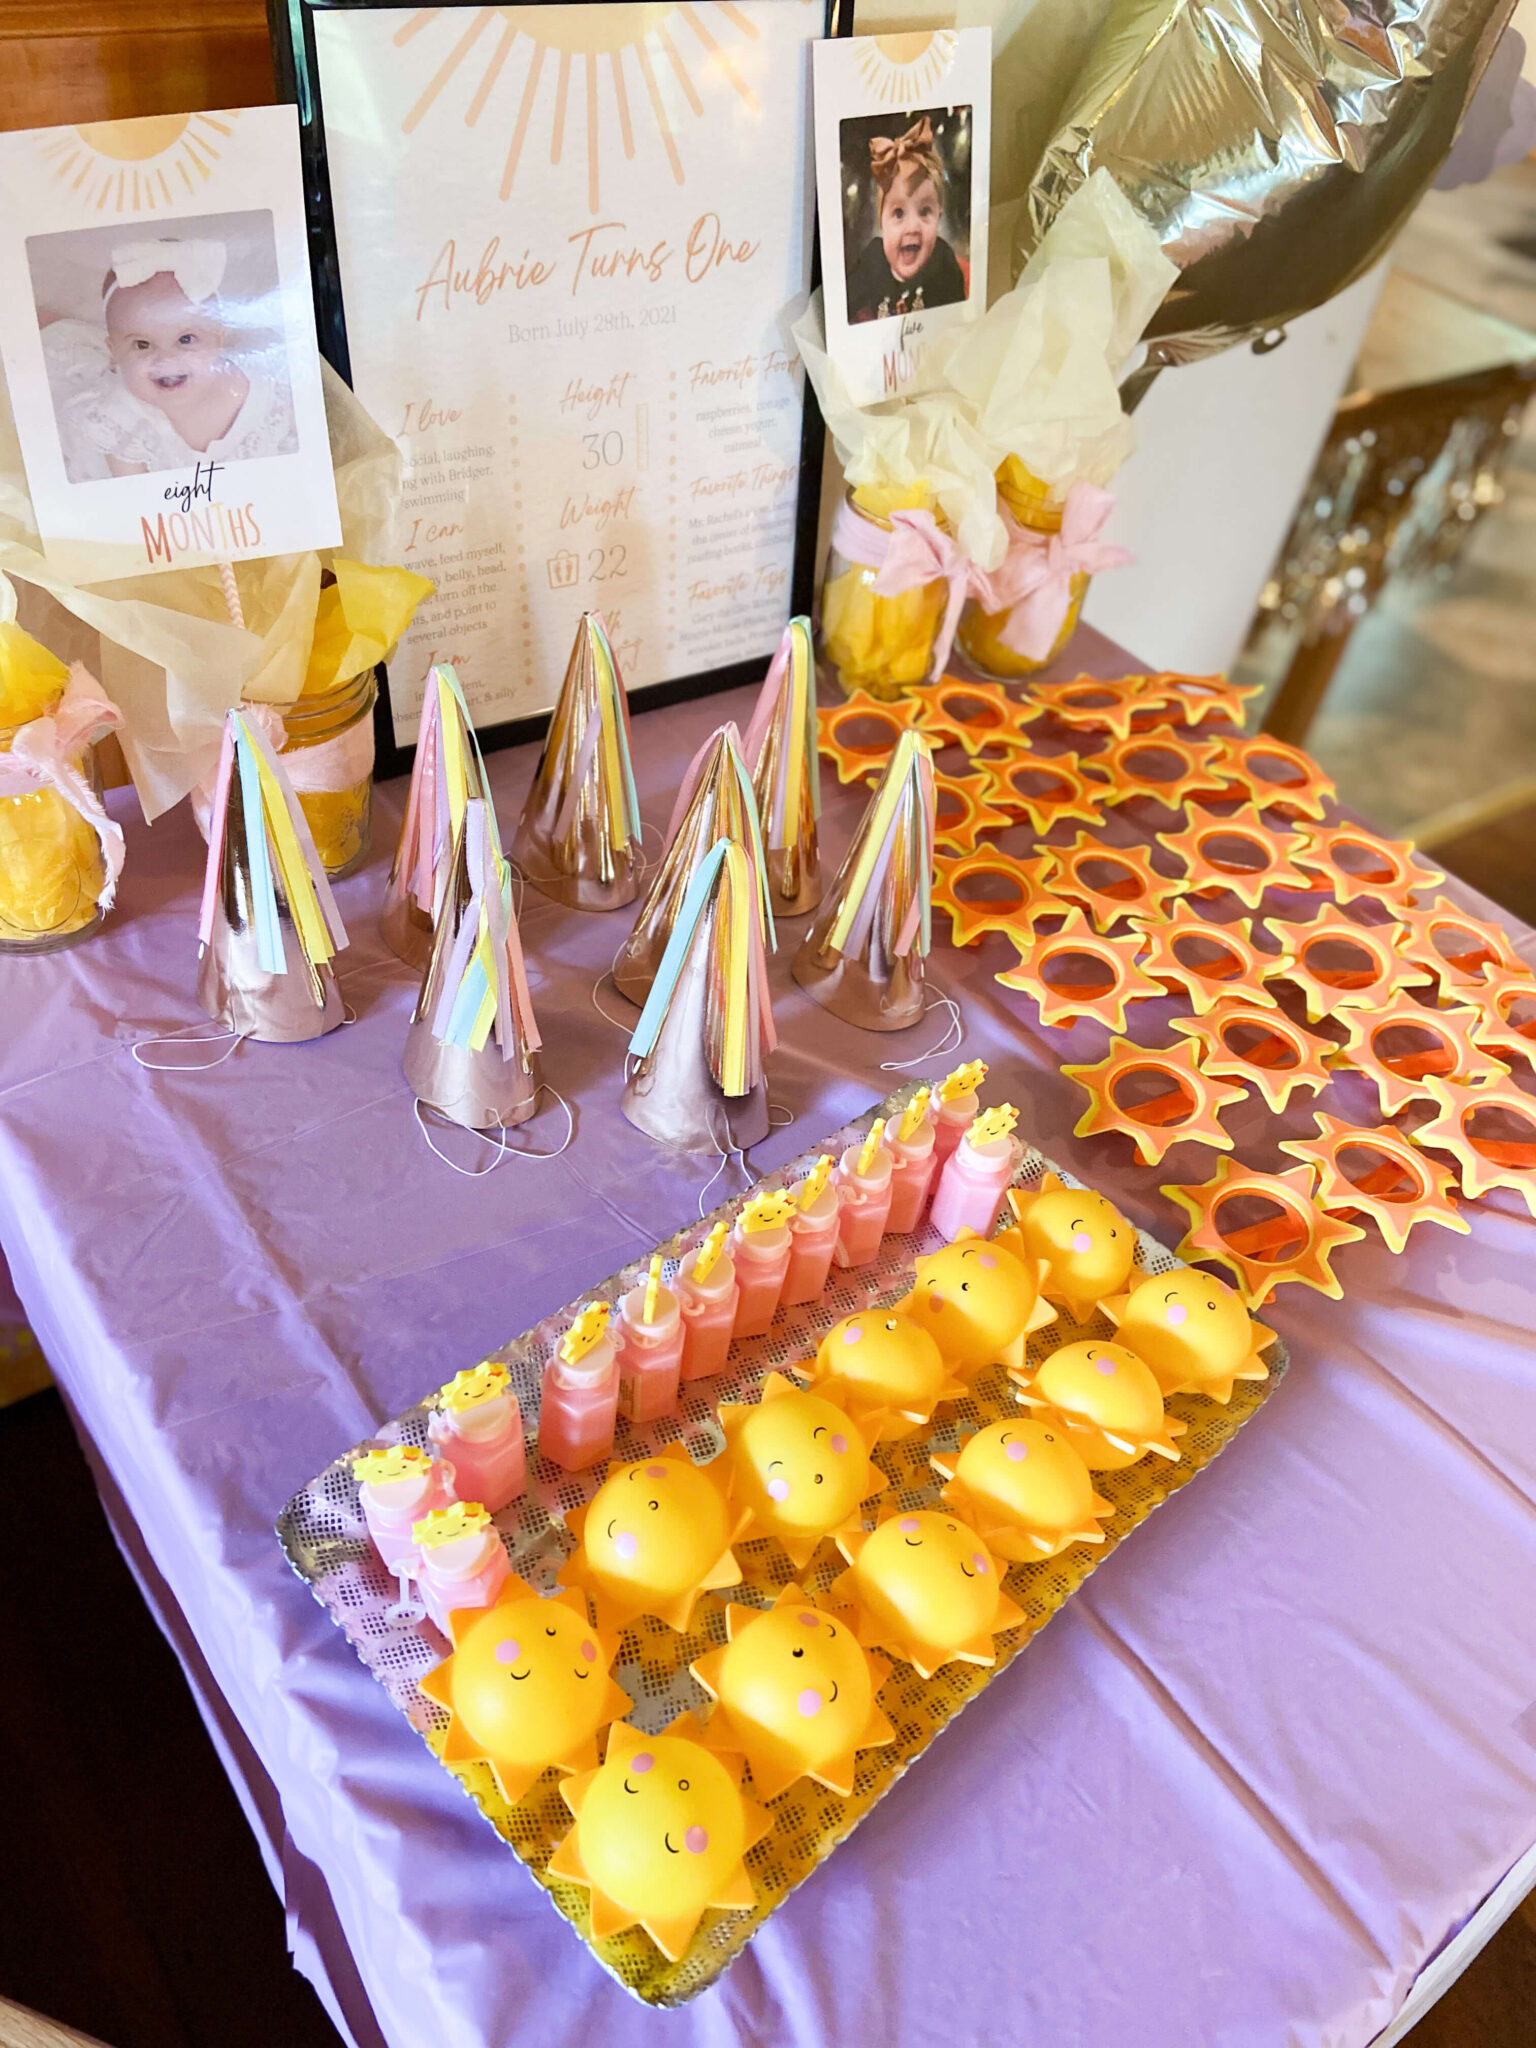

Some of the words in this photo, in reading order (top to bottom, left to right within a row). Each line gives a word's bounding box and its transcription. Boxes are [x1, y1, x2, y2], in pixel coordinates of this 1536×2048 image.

[416, 236, 557, 321] Aubrie
[568, 222, 674, 295] Turns
[685, 212, 760, 283] One
[508, 324, 550, 344] Born
[555, 317, 588, 340] July
[639, 305, 677, 327] 2021
[900, 316, 925, 352] five
[689, 354, 758, 392] Favorite
[560, 372, 637, 421] Height
[419, 399, 463, 432] love
[582, 431, 623, 470] 30
[164, 461, 225, 513] eight
[421, 470, 446, 486] with
[690, 471, 747, 503] Favorite
[752, 463, 797, 497] Things
[404, 488, 465, 509] swimming
[560, 486, 642, 532] Weight
[141, 502, 260, 564] MONTHS
[426, 523, 464, 542] can
[440, 550, 464, 565] feed
[588, 545, 628, 582] 22
[461, 584, 476, 598] off
[479, 582, 497, 595] the
[688, 570, 747, 608] Favorite
[754, 562, 787, 595] Toys
[431, 608, 451, 623] and
[454, 602, 482, 620] point
[485, 600, 497, 612] to
[407, 626, 447, 645] several
[449, 620, 488, 638] objects
